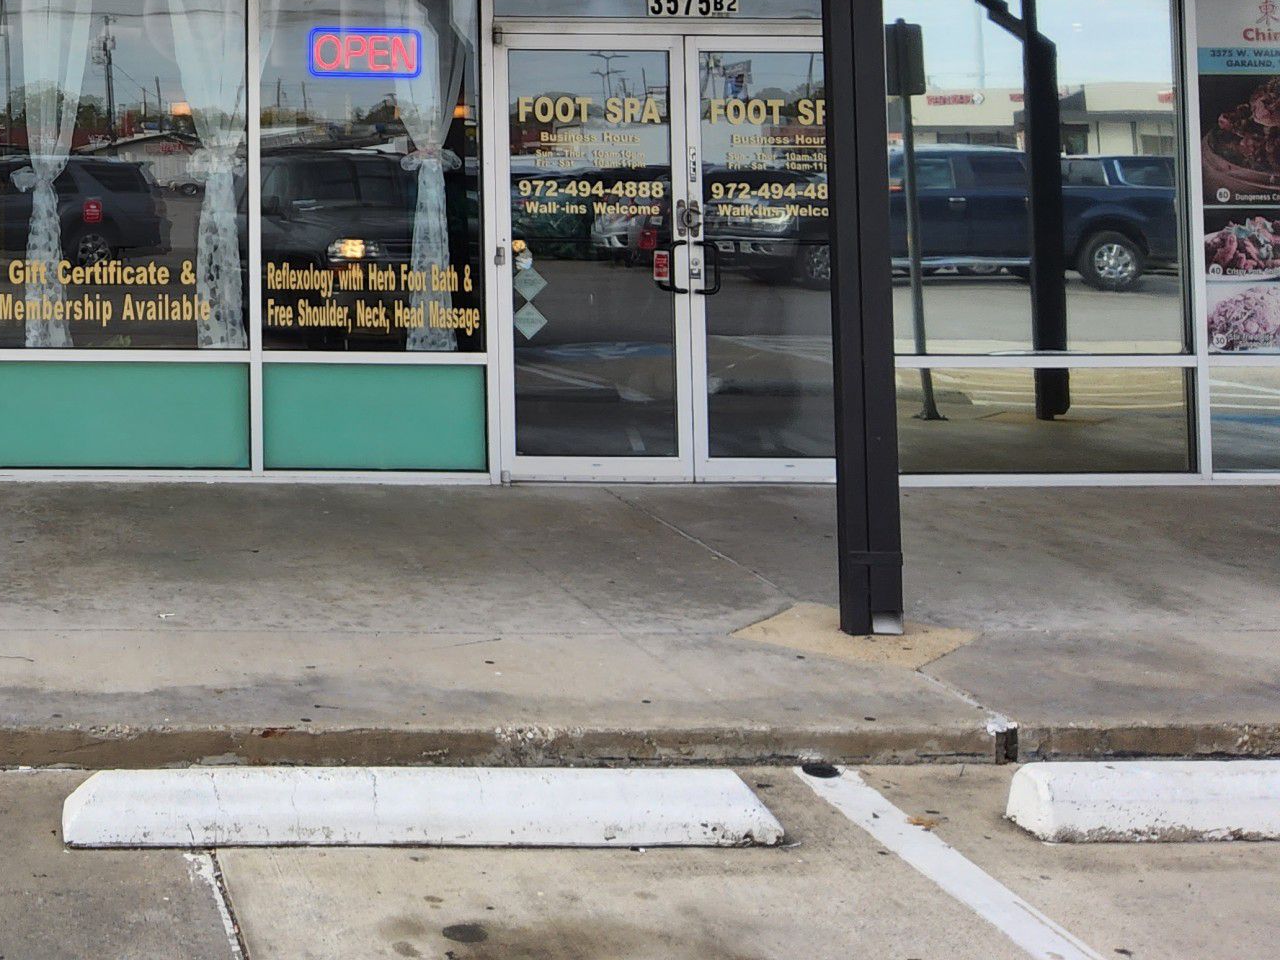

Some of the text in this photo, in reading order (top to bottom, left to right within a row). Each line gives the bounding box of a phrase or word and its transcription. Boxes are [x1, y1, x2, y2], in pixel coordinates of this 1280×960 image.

[314, 35, 416, 71] OPEN
[519, 96, 661, 124] FOOT SPA
[710, 99, 826, 126] FOOT SP
[540, 131, 640, 143] Business Hours
[732, 134, 826, 145] Business Hour
[728, 161, 740, 170] Fri
[751, 161, 767, 170] Sat
[518, 180, 664, 198] 972-494-4888
[711, 182, 828, 200] 972-494-48
[1235, 193, 1271, 202] Dungeness
[593, 201, 660, 215] Welcome
[718, 204, 780, 217] Walk-ins
[8, 260, 196, 284] Gift Certificate &
[267, 262, 334, 298] Reflexology
[338, 263, 364, 291] with
[368, 263, 396, 291] Herb
[431, 265, 458, 291] Bath
[463, 264, 473, 291] &
[122, 293, 210, 321] Available
[267, 299, 293, 326] Free
[297, 299, 352, 333] Shoulder,
[356, 300, 390, 333] Neck,
[394, 300, 424, 327] Head
[429, 301, 480, 336] Massage
